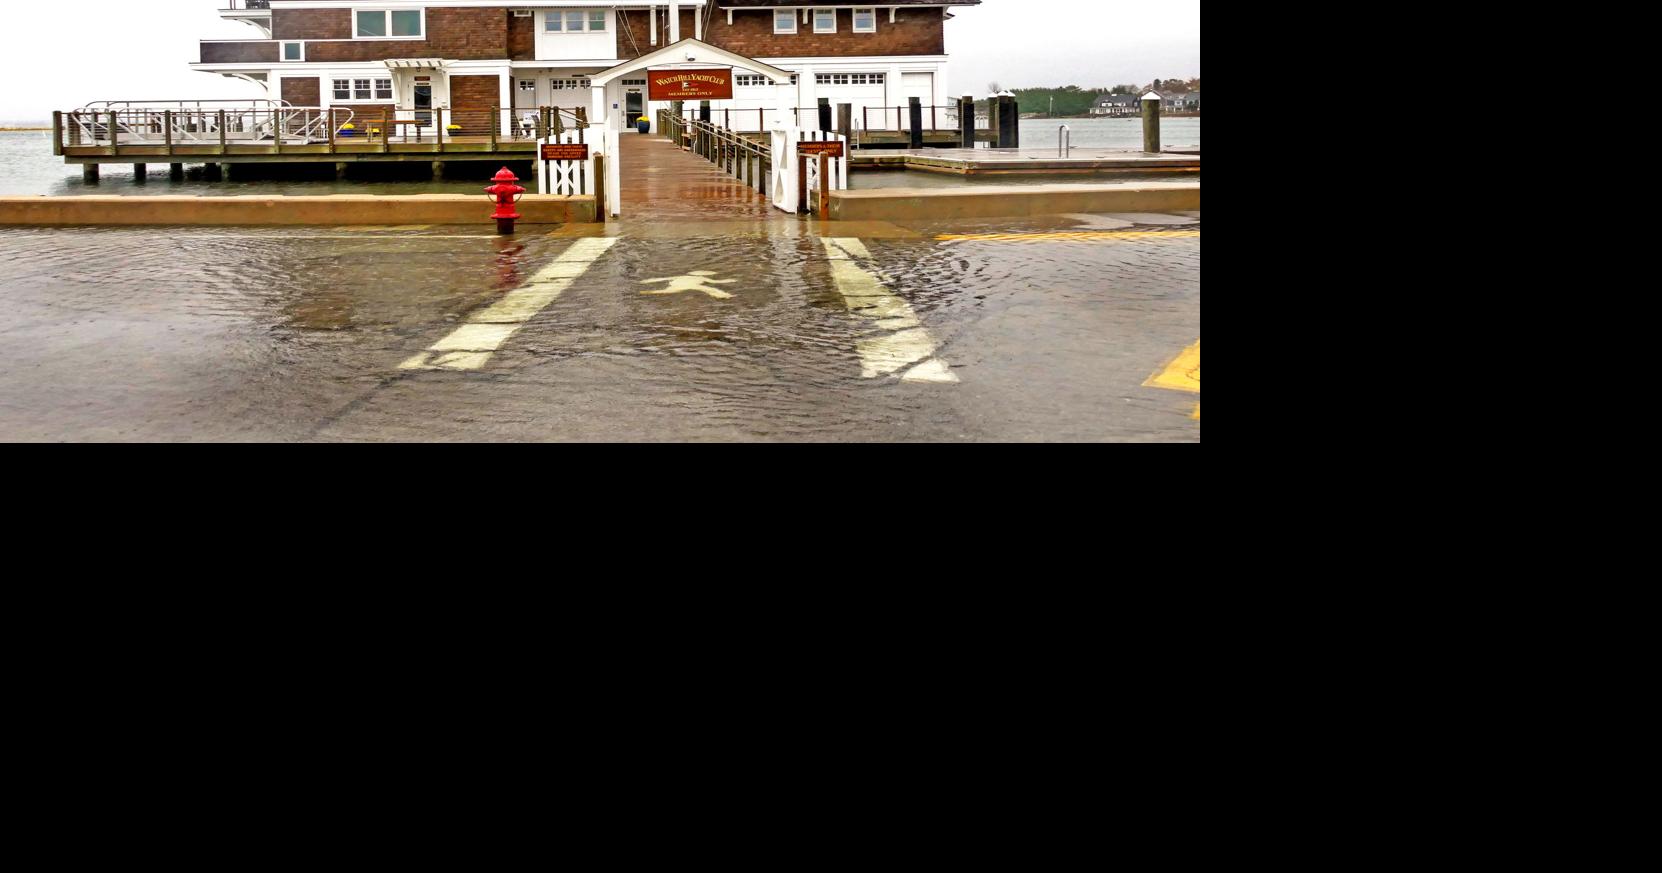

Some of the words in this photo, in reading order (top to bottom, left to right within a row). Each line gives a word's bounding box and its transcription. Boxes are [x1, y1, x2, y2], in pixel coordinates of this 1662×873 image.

[656, 76, 678, 85] WATCH
[691, 74, 710, 82] YACHT
[709, 75, 725, 85] CLUB
